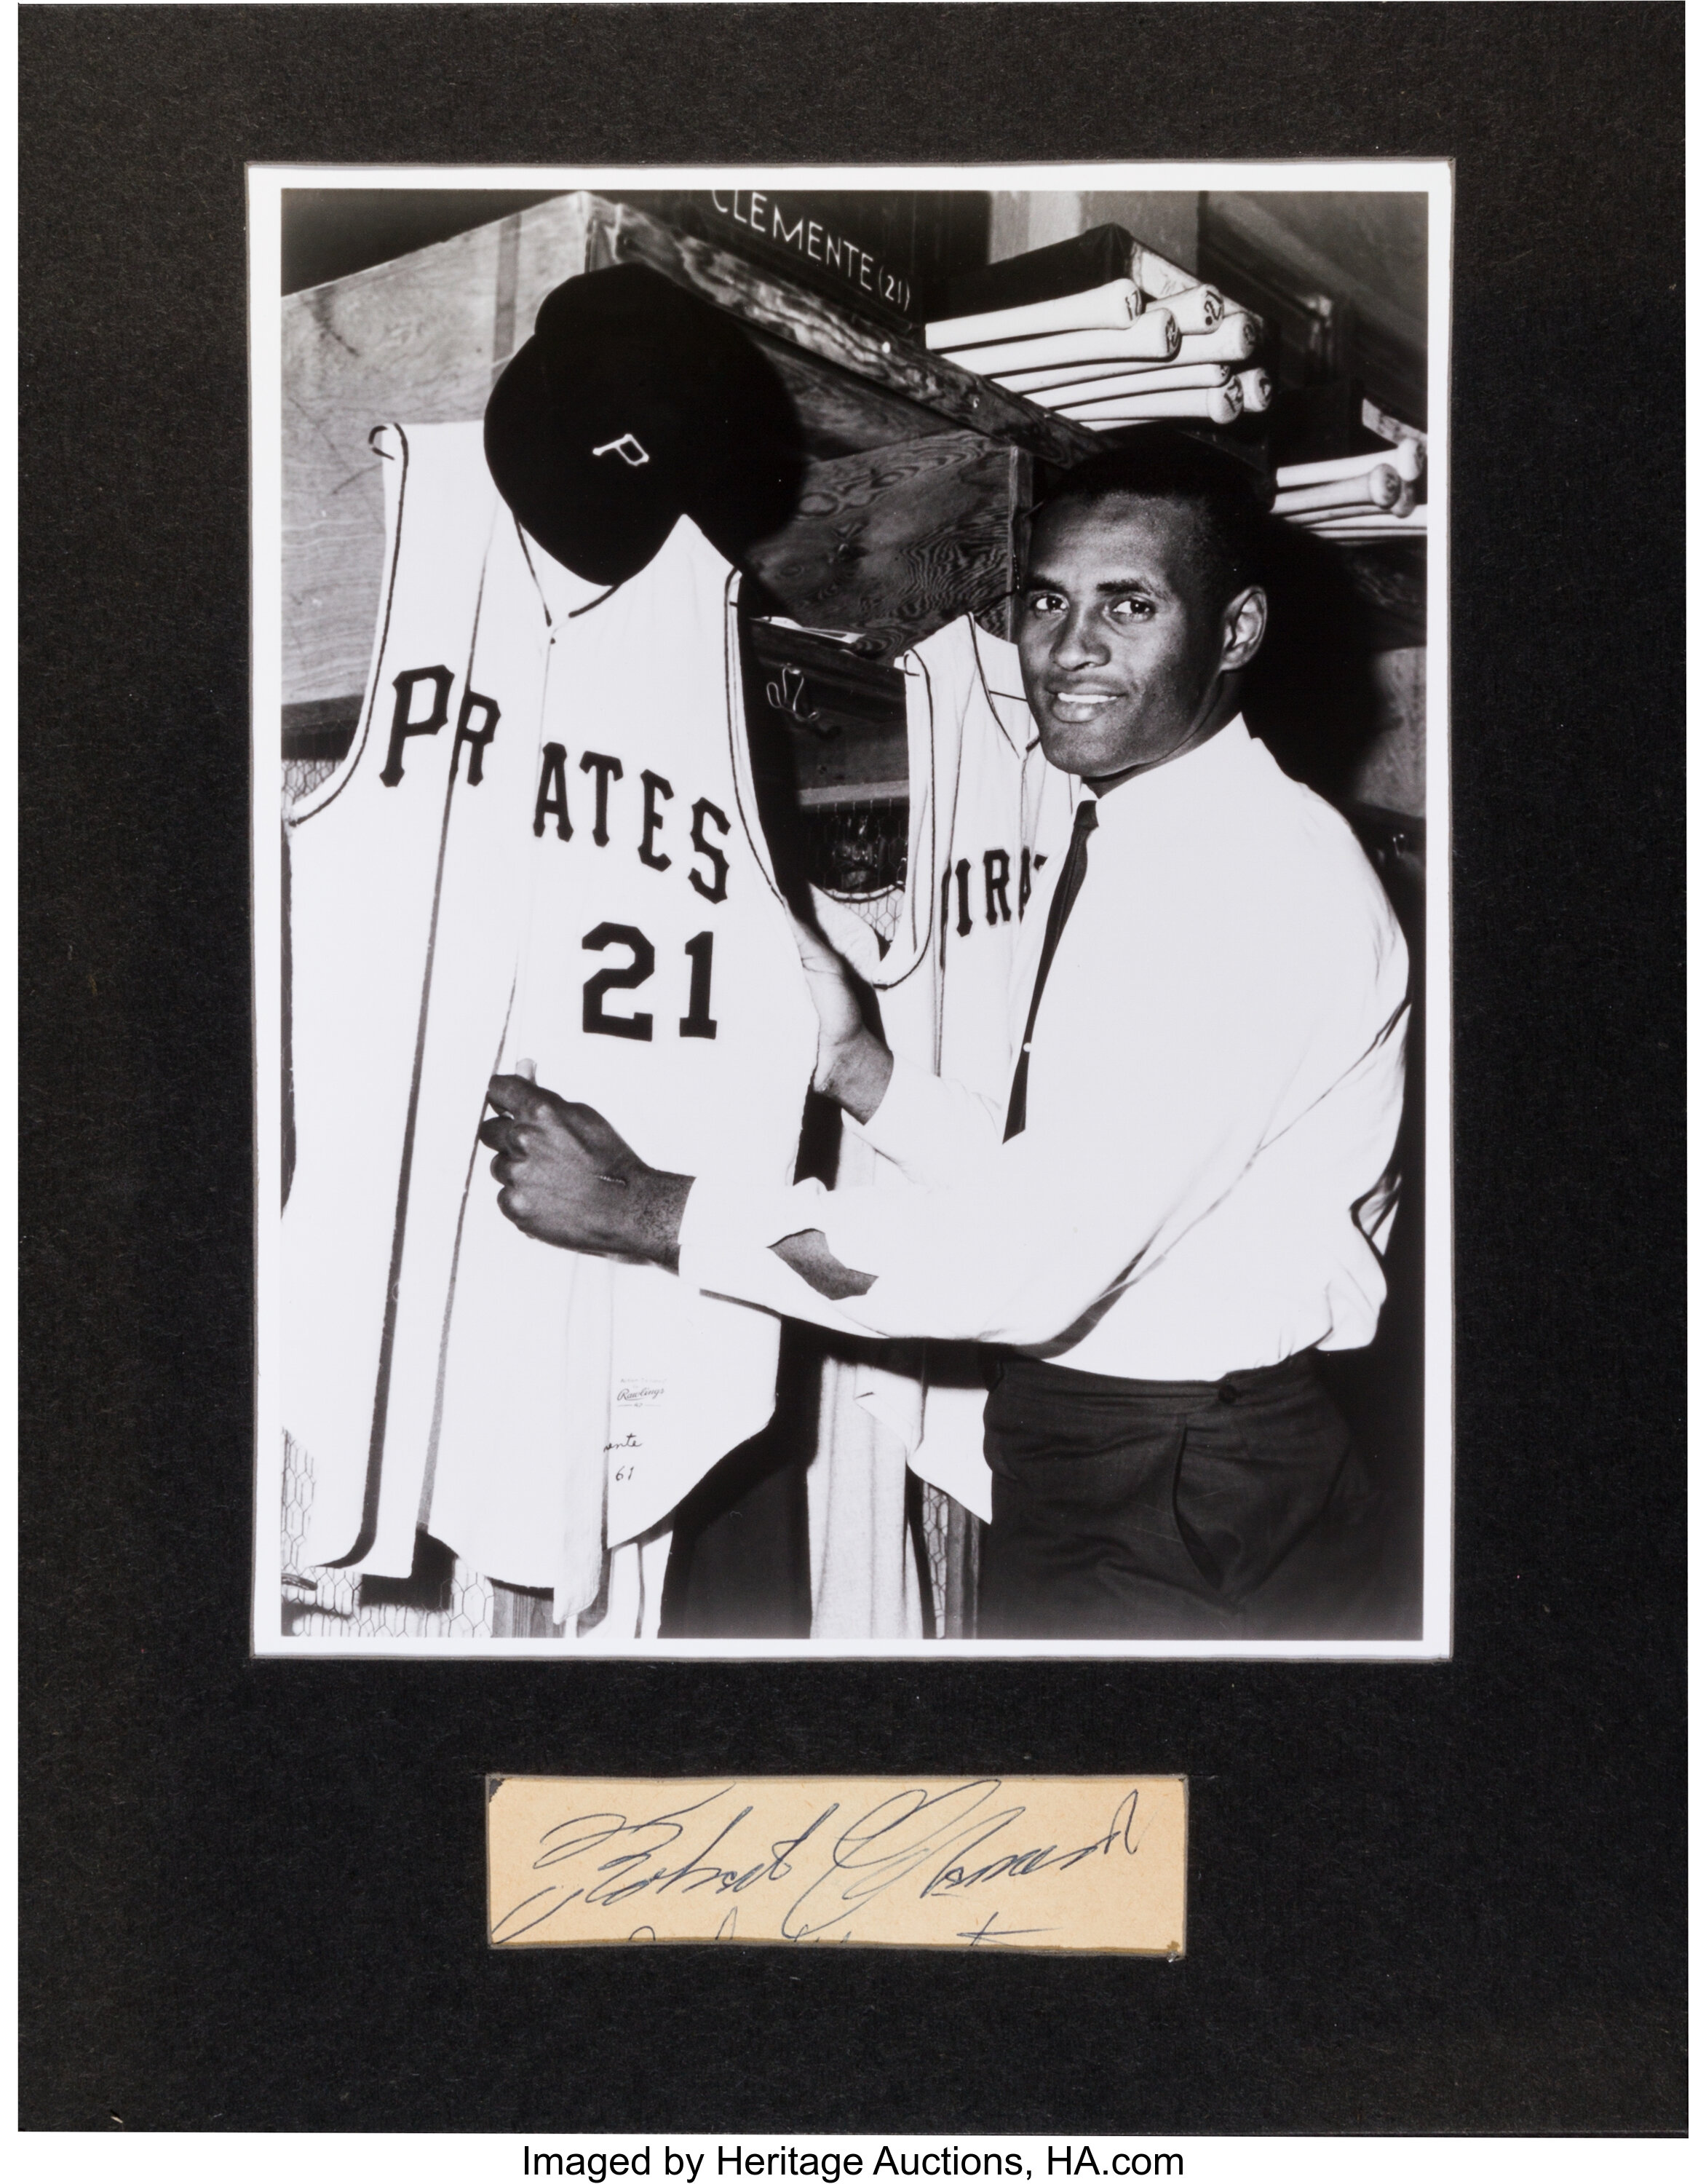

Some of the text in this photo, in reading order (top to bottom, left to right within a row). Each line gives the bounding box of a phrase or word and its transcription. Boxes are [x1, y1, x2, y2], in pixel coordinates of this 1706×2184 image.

[712, 190, 873, 290] CLEMENTE
[592, 433, 649, 466] P
[582, 922, 718, 1042] 21
[616, 1387, 665, 1401] Rawlings
